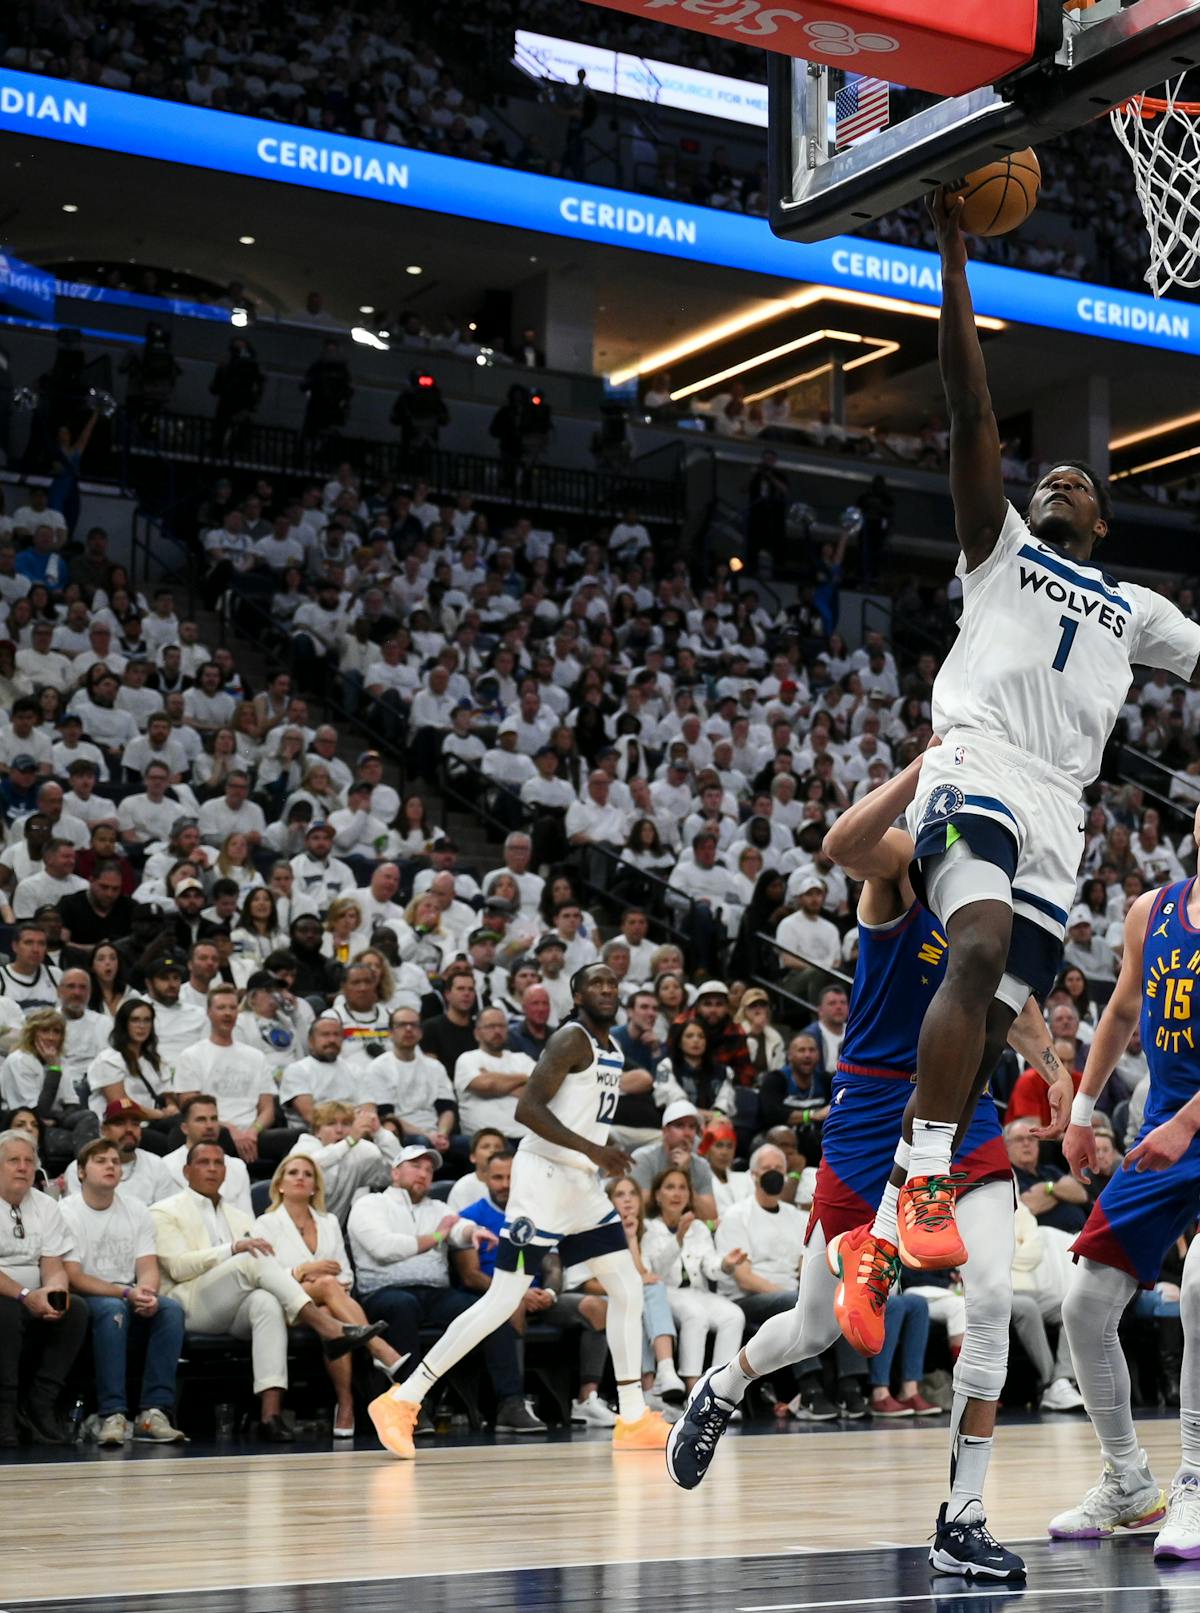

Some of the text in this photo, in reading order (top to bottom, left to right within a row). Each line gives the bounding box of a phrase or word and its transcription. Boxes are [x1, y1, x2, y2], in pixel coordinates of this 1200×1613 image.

[644, 0, 803, 35] Sta
[257, 137, 409, 189] CERIDIAN
[559, 196, 697, 244] CERIDIAN
[1076, 297, 1190, 340] CERIDIAN
[1020, 567, 1126, 639] WOLVES
[1052, 614, 1079, 673] 1
[1163, 902, 1174, 914] 6
[1147, 949, 1181, 998] MILE
[1164, 978, 1194, 1020] 15
[1155, 1026, 1195, 1053] CITY
[596, 1091, 616, 1125] 12
